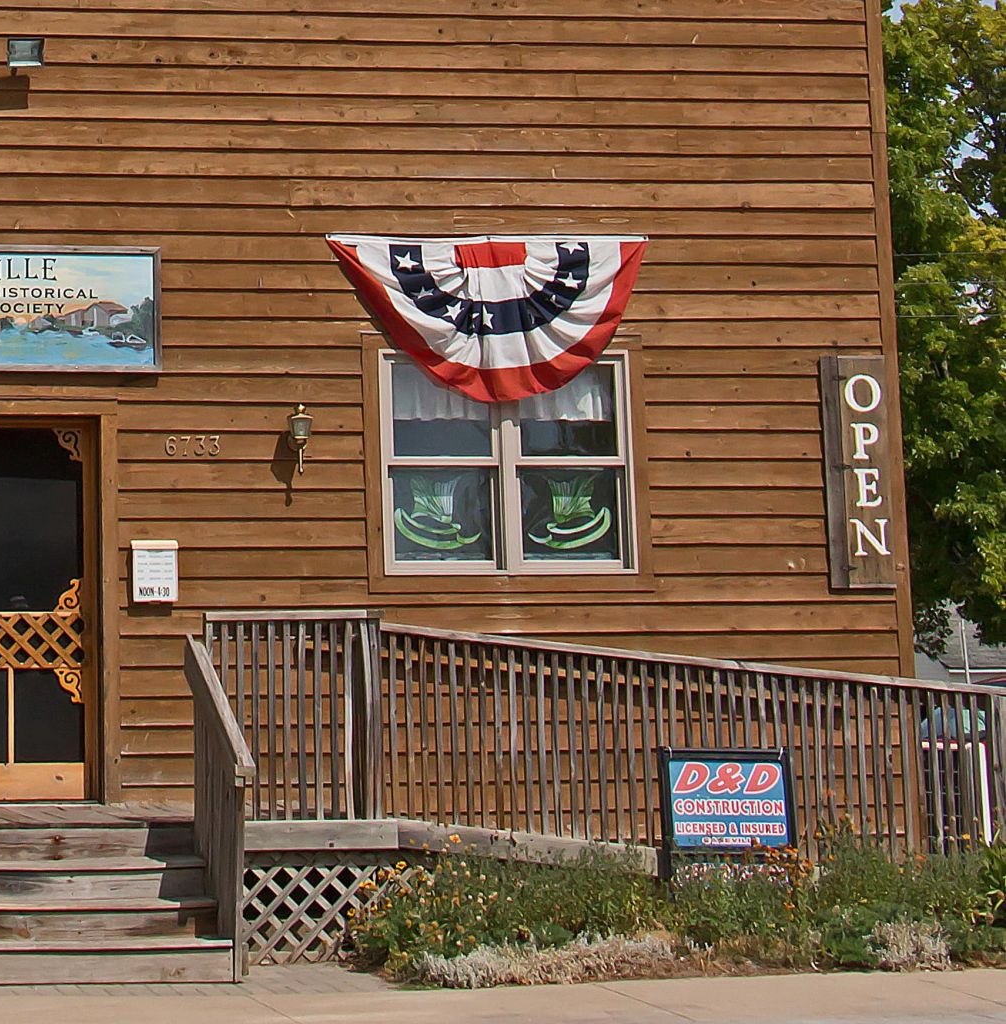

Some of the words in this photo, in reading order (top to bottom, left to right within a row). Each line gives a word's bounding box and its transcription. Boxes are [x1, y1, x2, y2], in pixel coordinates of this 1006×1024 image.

[165, 436, 220, 456] 6733
[844, 374, 891, 557] OPEN
[673, 762, 781, 795] D&D
[674, 799, 785, 815] CONSTRUCTION
[676, 823, 725, 835] LICENSED
[729, 823, 739, 835] &
[741, 823, 786, 835] INSURED
[702, 837, 760, 845] CASEVILL
